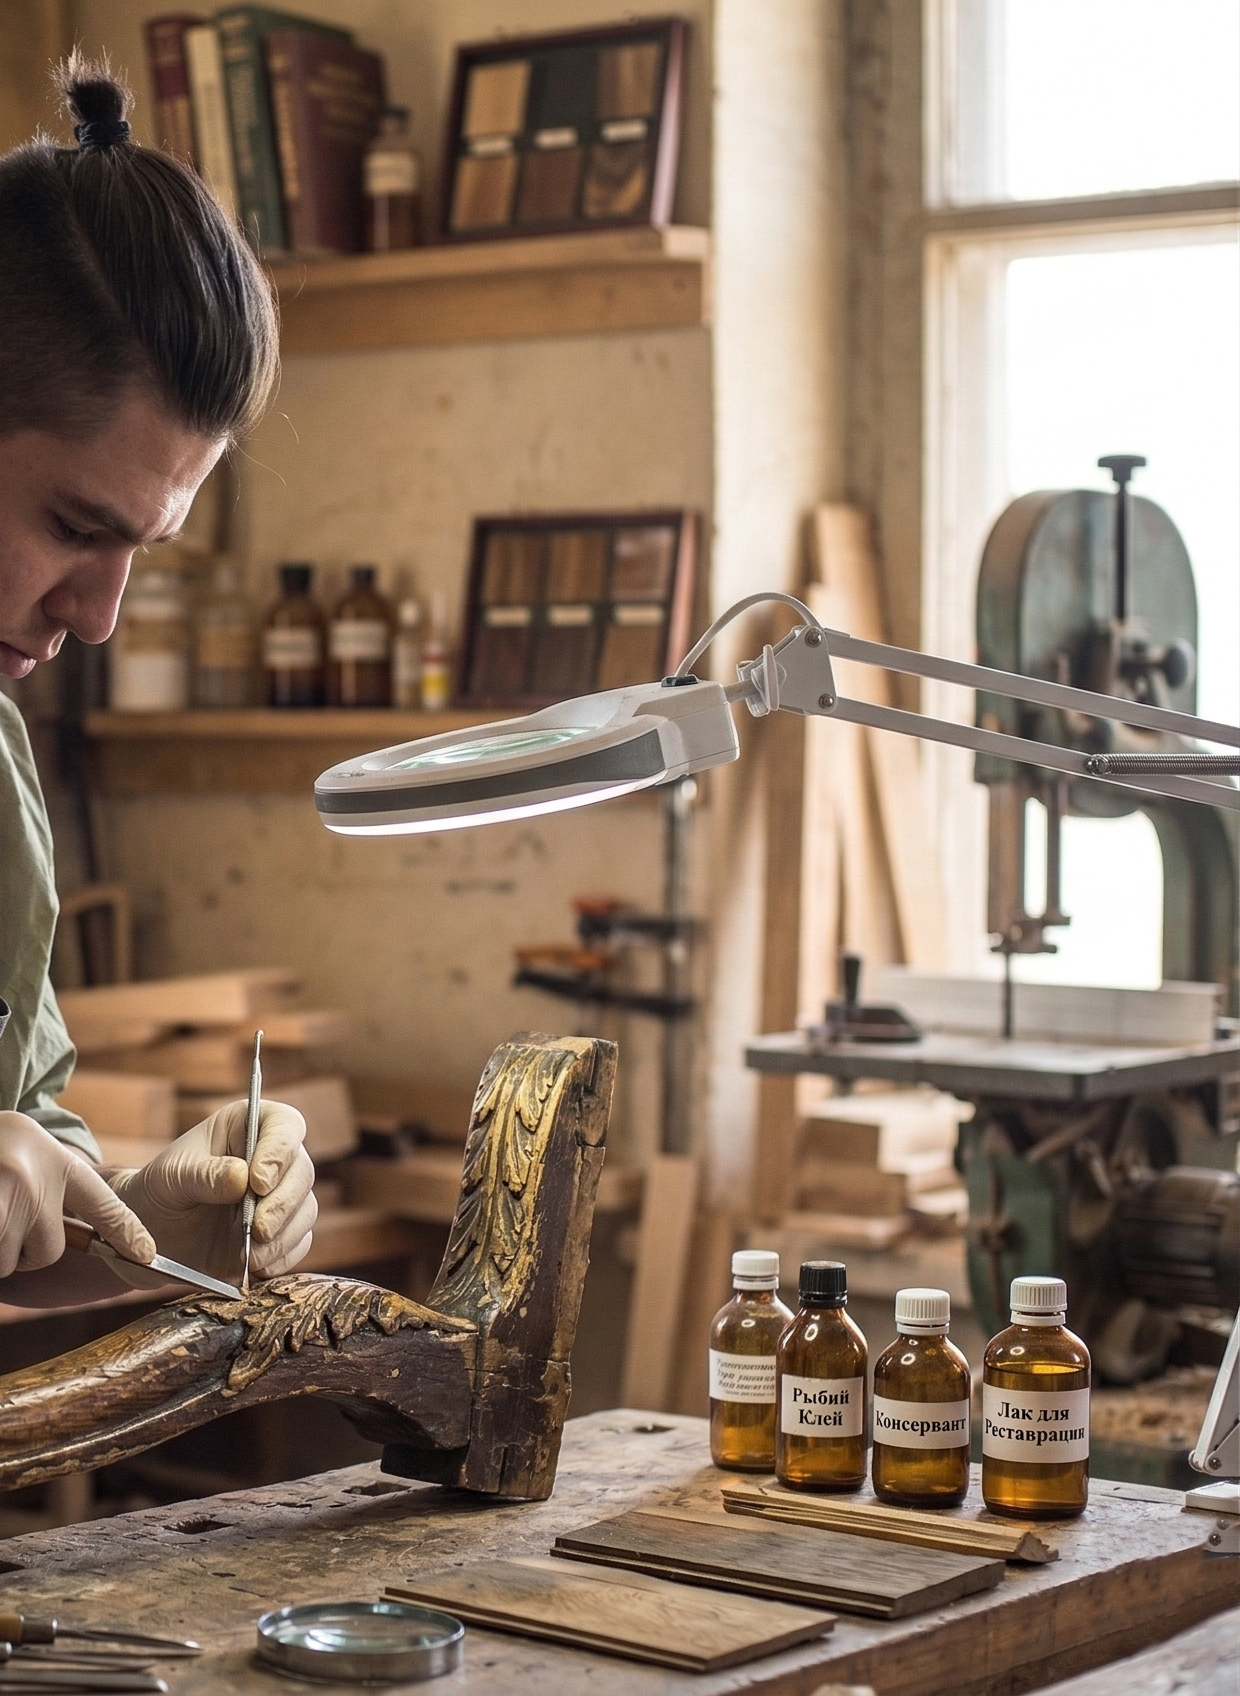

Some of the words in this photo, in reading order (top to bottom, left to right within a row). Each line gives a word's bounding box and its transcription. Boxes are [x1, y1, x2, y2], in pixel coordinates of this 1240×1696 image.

[793, 1387, 850, 1405] Рыбий
[798, 1409, 843, 1426] Клей
[997, 1401, 1033, 1420] Лак
[1036, 1409, 1070, 1422] для
[876, 1410, 966, 1436] Консервант
